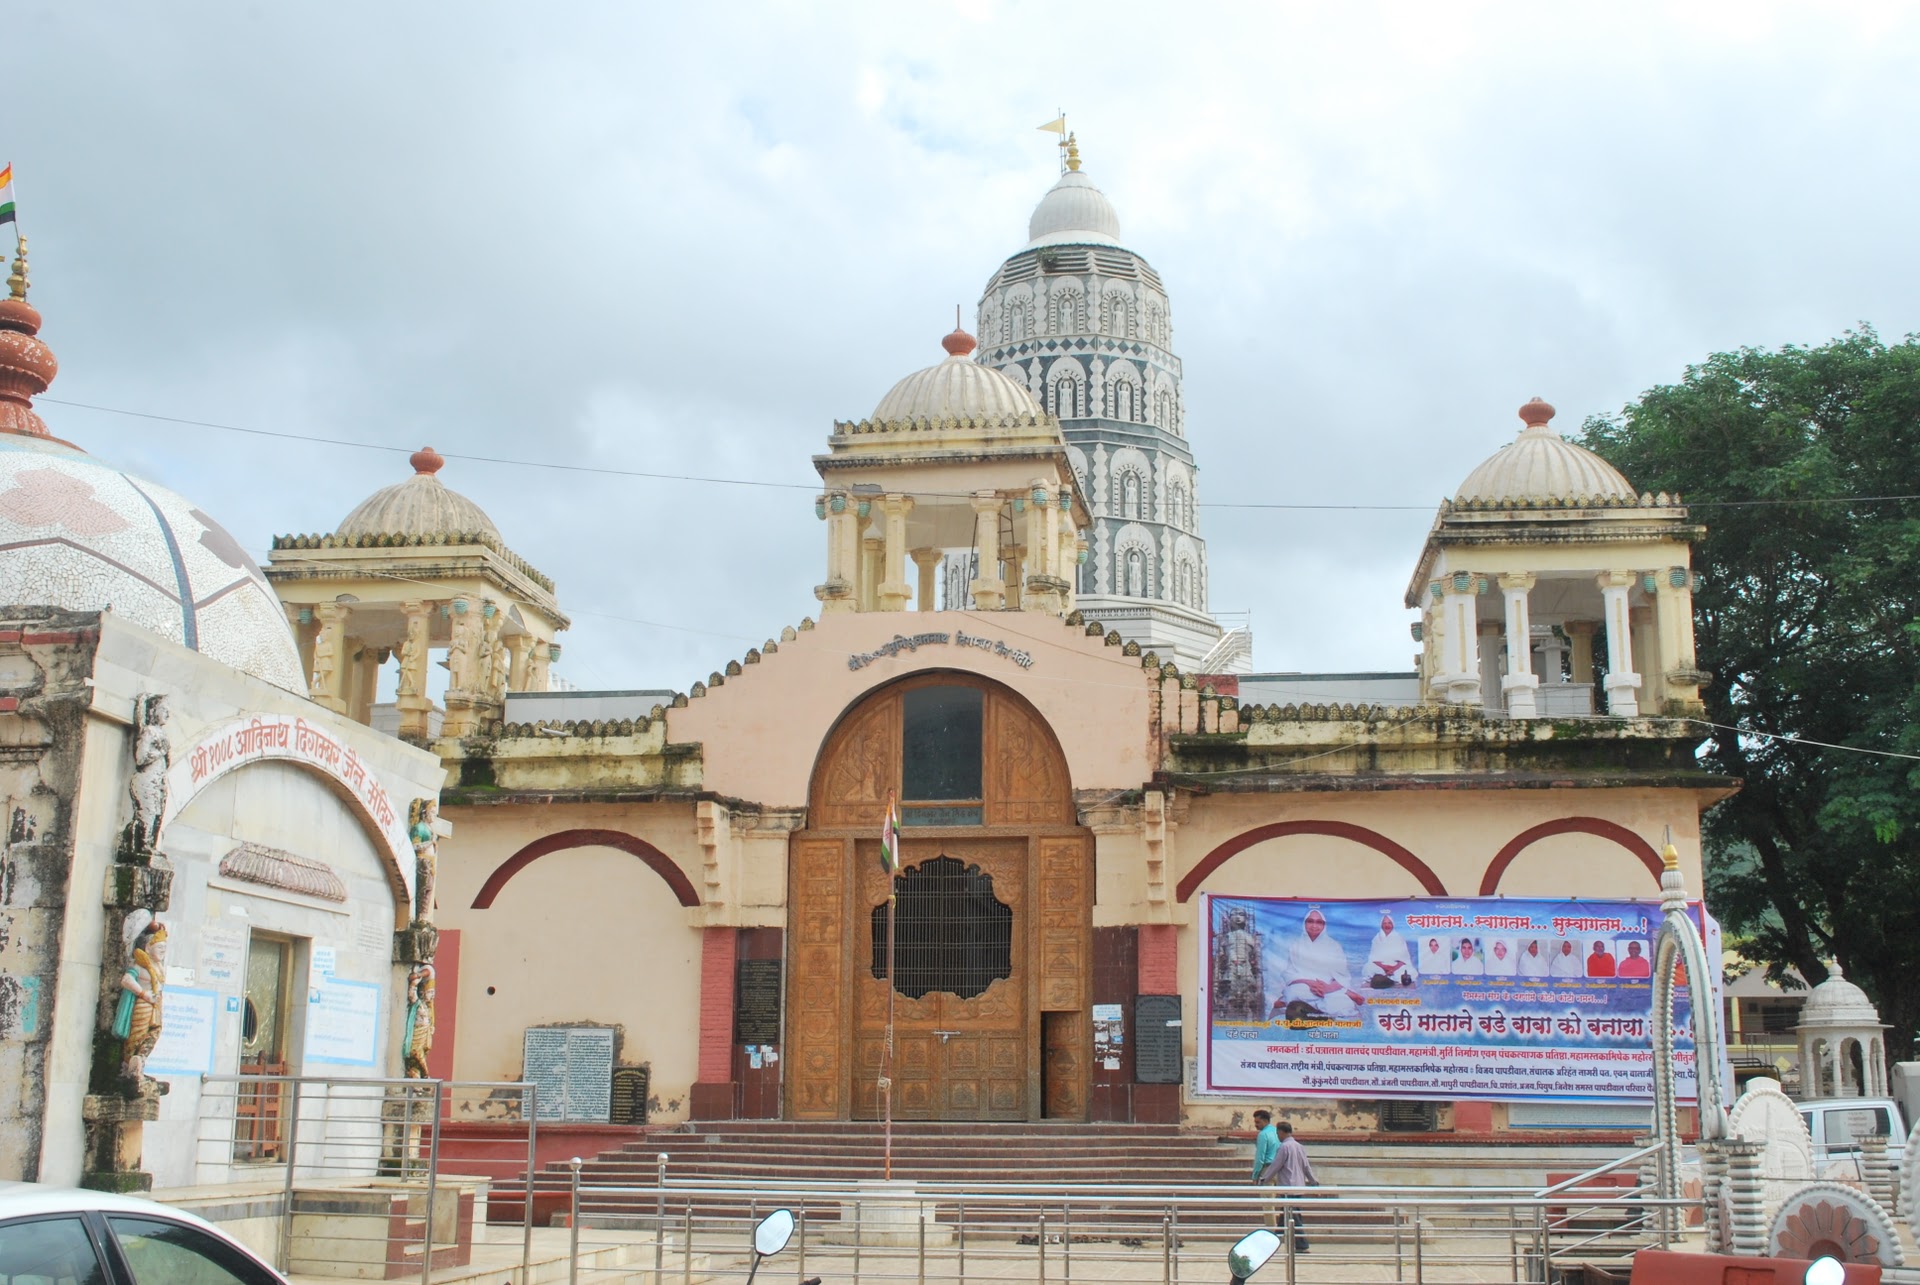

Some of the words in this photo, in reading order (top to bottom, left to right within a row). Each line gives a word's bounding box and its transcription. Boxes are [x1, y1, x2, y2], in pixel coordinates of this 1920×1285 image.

[993, 640, 1010, 660] जैन
[191, 745, 208, 783] श्री
[209, 735, 235, 771] १००८
[236, 718, 290, 757] आदिनाथ
[294, 716, 342, 771] दिगम्बर
[342, 748, 366, 791] जैन
[367, 779, 394, 836] मंदिर
[1501, 989, 1510, 1001] के
[1378, 1009, 1412, 1031] बडी
[1417, 1009, 1473, 1032] माताने
[1478, 1010, 1506, 1033] बडे
[1511, 1016, 1552, 1034] बाबा
[1557, 1012, 1582, 1035] को
[1587, 1018, 1643, 1036] बनाया
[1267, 1044, 1299, 1054] नमनकर्ता
[1345, 1045, 1369, 1056] बालचंद
[1455, 1047, 1479, 1058] निर्माण
[1481, 1050, 1497, 1061] एवम्
[1240, 1059, 1256, 1069] संजय
[1443, 1064, 1469, 1075] महोत्सव
[1475, 1064, 1494, 1075] विजय
[1556, 1066, 1576, 1077] अरिहंत
[1613, 1069, 1628, 1080] एवम्
[1575, 1084, 1593, 1092] समस्त
[1594, 1083, 1624, 1092] पापडीवाल
[1625, 1083, 1646, 1093] परिवार
